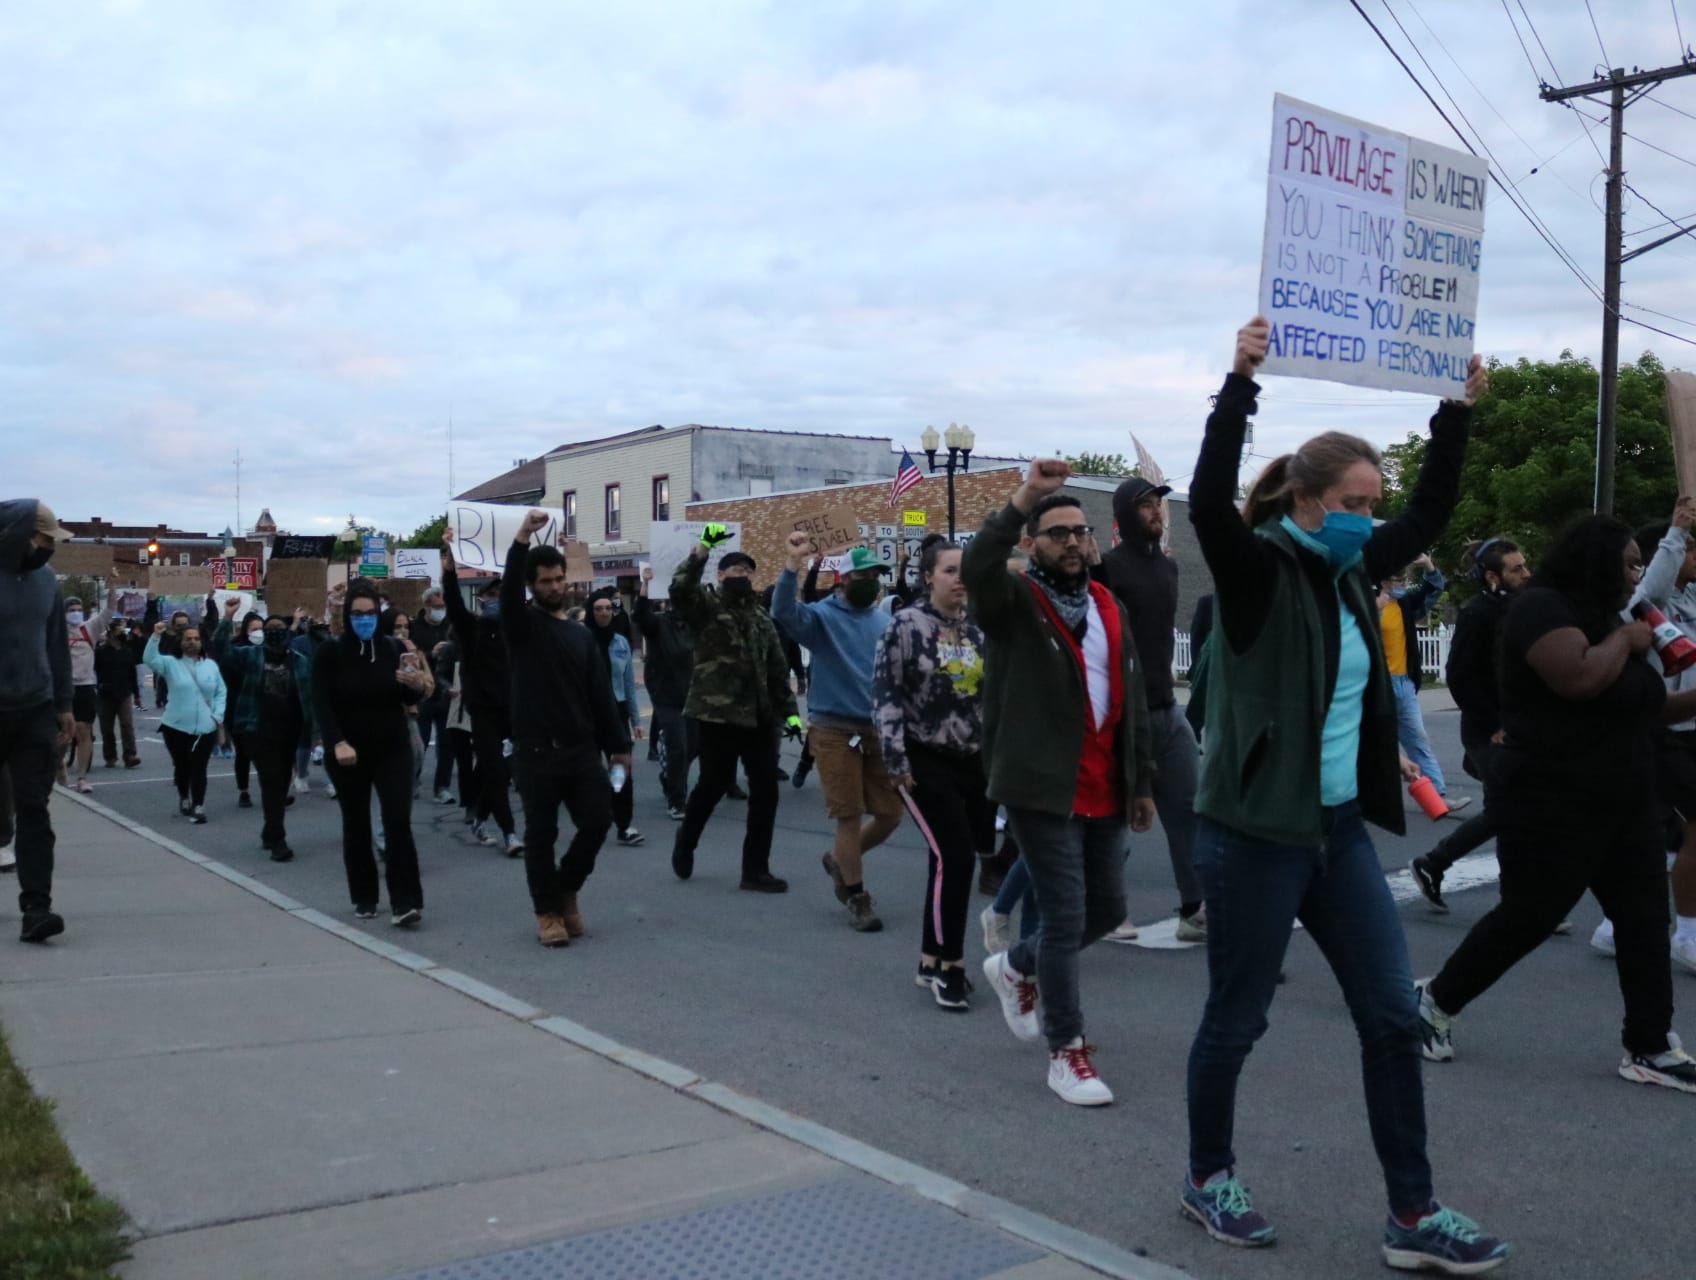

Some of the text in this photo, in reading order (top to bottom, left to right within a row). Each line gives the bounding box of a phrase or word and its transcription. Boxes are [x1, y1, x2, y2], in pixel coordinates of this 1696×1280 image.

[1283, 117, 1484, 212] PRIVILAGE IS WHEN
[1280, 184, 1481, 272] YOU THINK SOMETHING
[1278, 243, 1458, 303] IS NOT A PROBLEM
[1272, 278, 1476, 341] BECAUSE YOU ARE NOT
[1267, 322, 1366, 363] AFFECTED
[793, 514, 833, 534] FREE
[906, 513, 923, 521] TRUCK
[881, 527, 892, 536] TO
[905, 527, 924, 536] SOUTH
[882, 544, 892, 561] 5
[907, 545, 921, 558] 14
